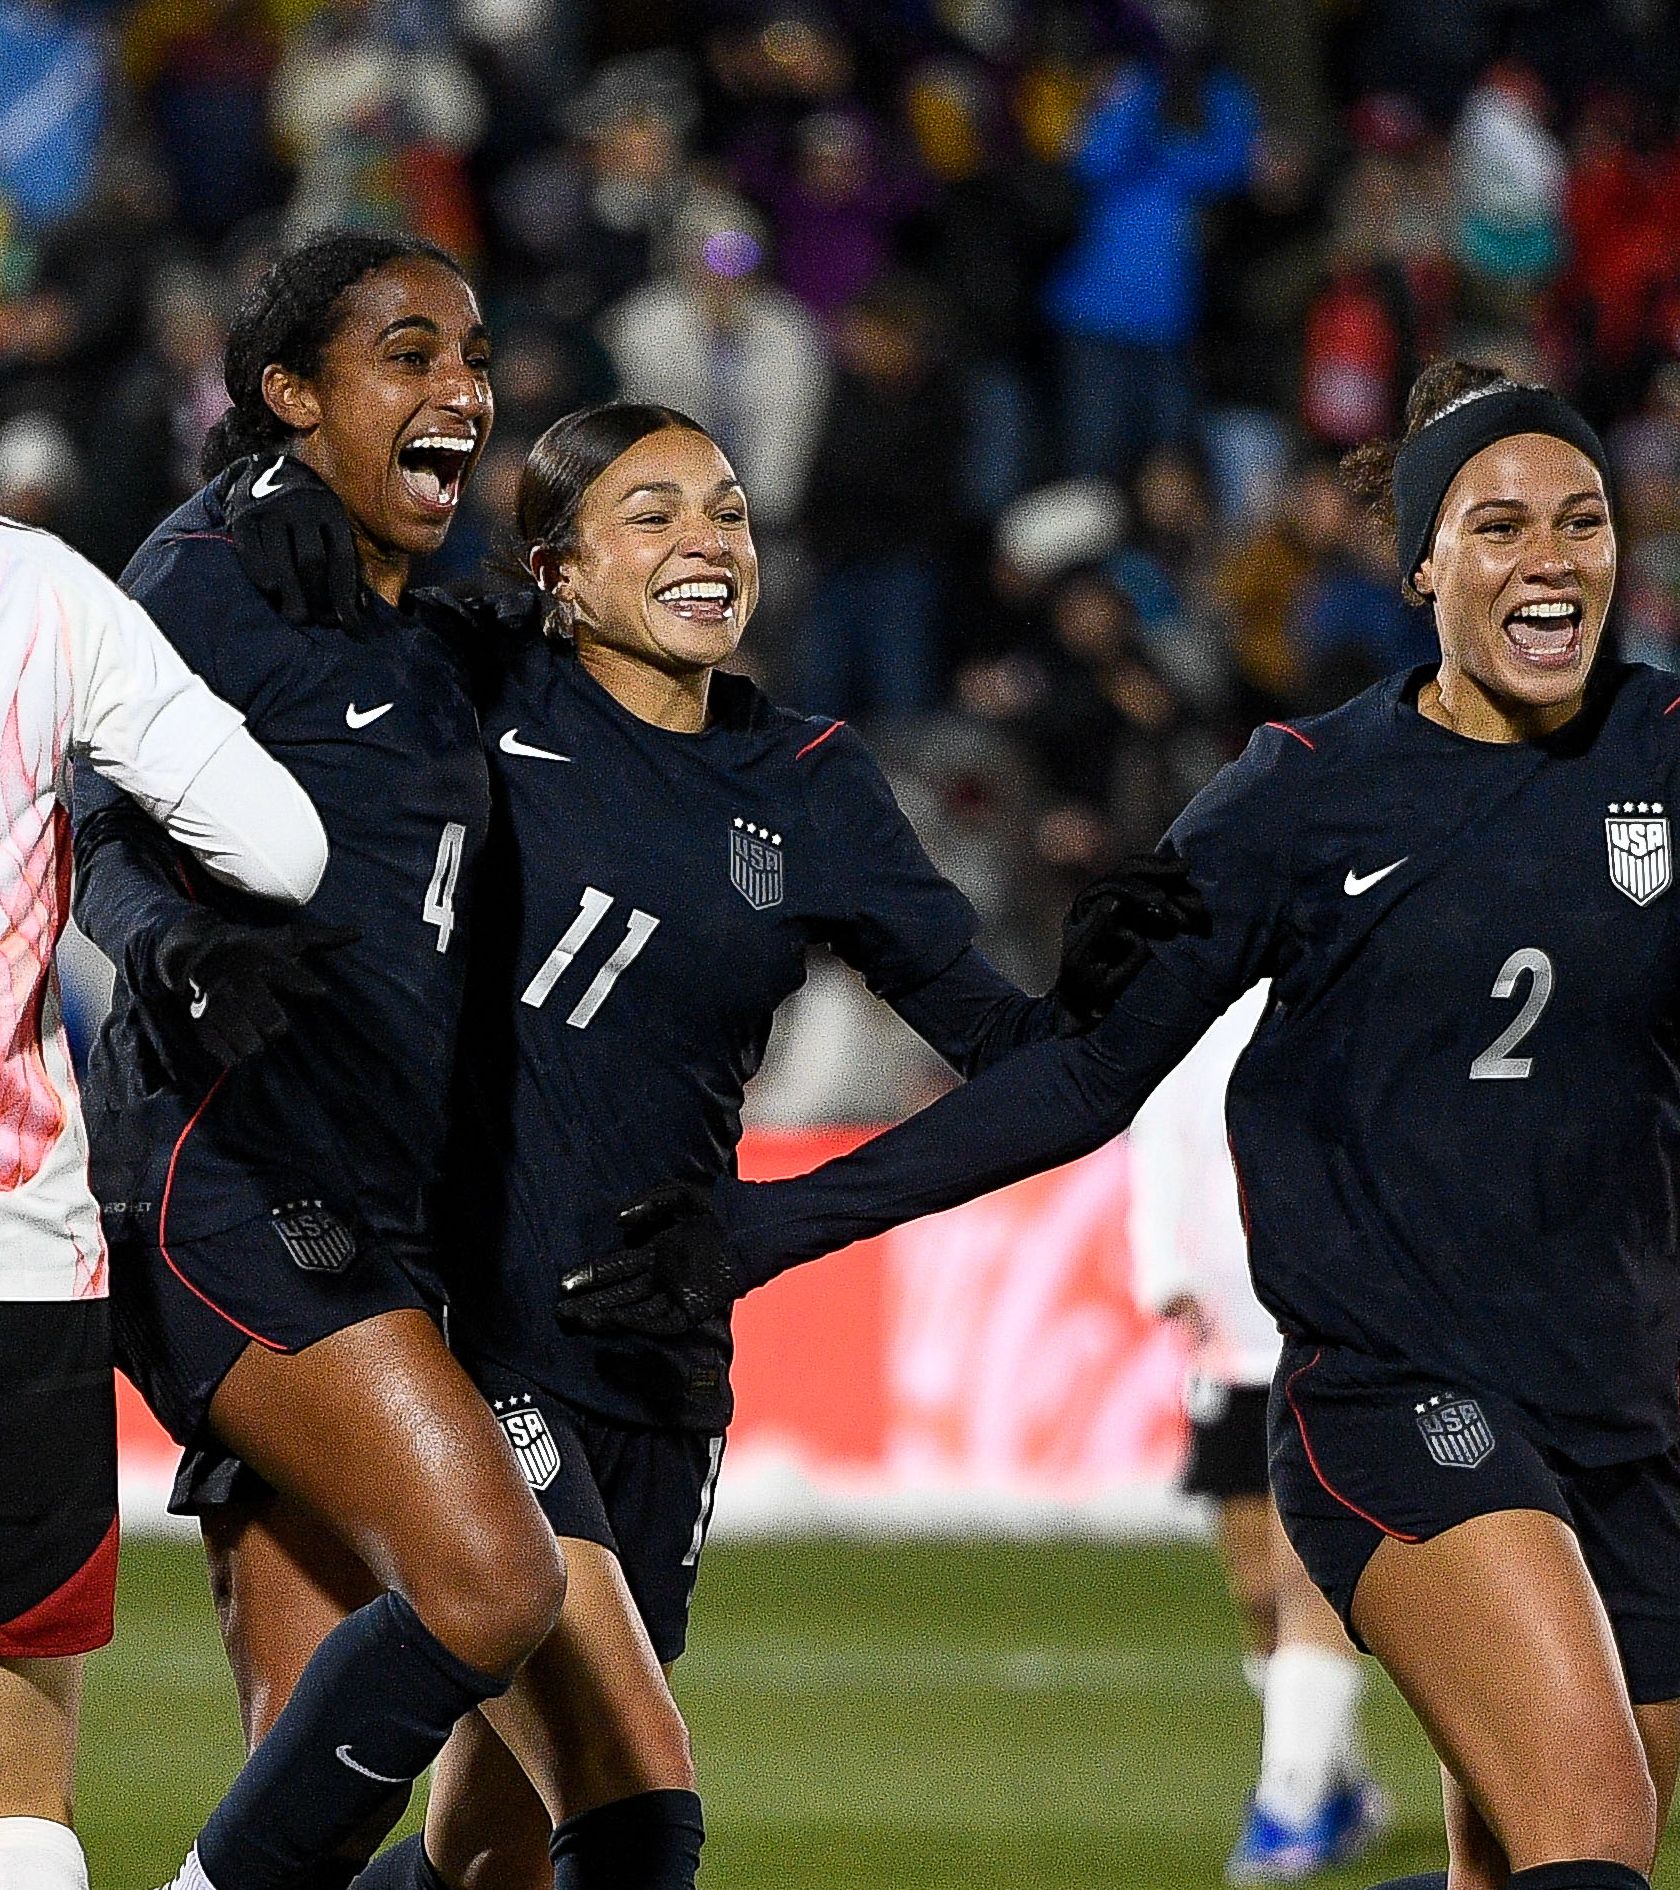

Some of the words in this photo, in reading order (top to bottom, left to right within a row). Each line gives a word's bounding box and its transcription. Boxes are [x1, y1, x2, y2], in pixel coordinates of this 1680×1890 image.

[735, 836, 778, 870] USA
[1610, 823, 1663, 857] USA
[423, 821, 466, 954] 4
[520, 886, 661, 1029] 11
[1468, 947, 1555, 1080] 2
[500, 1413, 543, 1447] SA
[1421, 1404, 1478, 1433] USA
